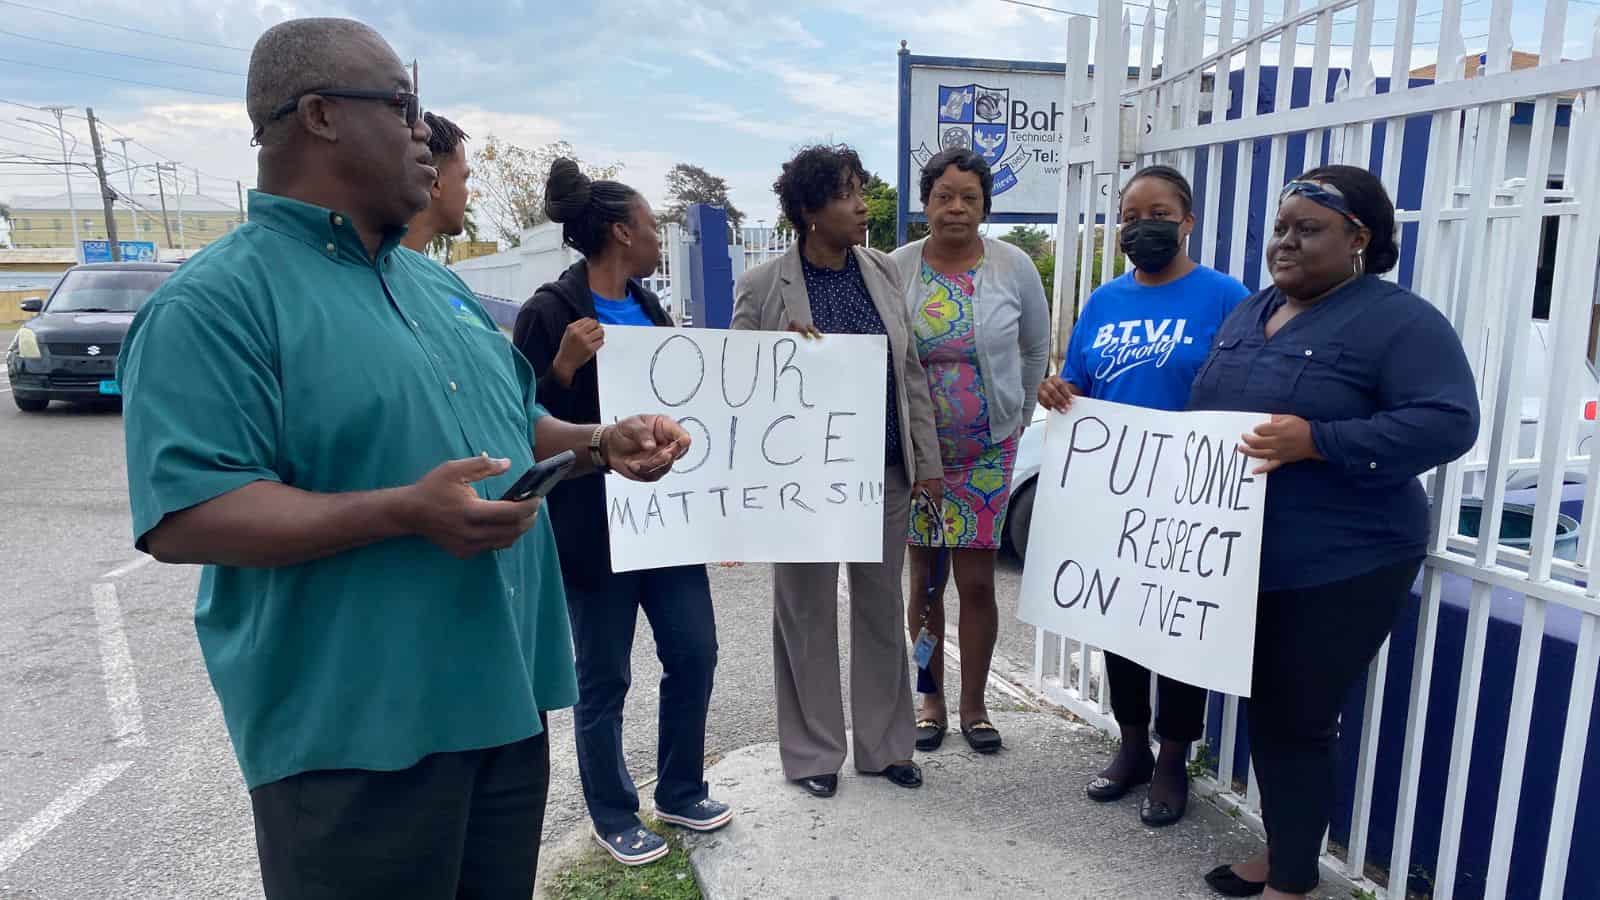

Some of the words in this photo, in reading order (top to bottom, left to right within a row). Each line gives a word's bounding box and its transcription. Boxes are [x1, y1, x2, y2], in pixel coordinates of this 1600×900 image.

[1010, 131, 1056, 143] Technical
[1032, 149, 1059, 162] Tel:
[1092, 319, 1193, 349] B.T.V.I.
[1095, 339, 1176, 380] Strong
[649, 334, 815, 408] OUR
[614, 412, 857, 474] OICE
[1060, 416, 1174, 498] PUT
[1174, 430, 1255, 511] SOME
[1117, 508, 1242, 578] RESPECT
[1053, 559, 1121, 616] ON
[1138, 581, 1220, 641] TVET
